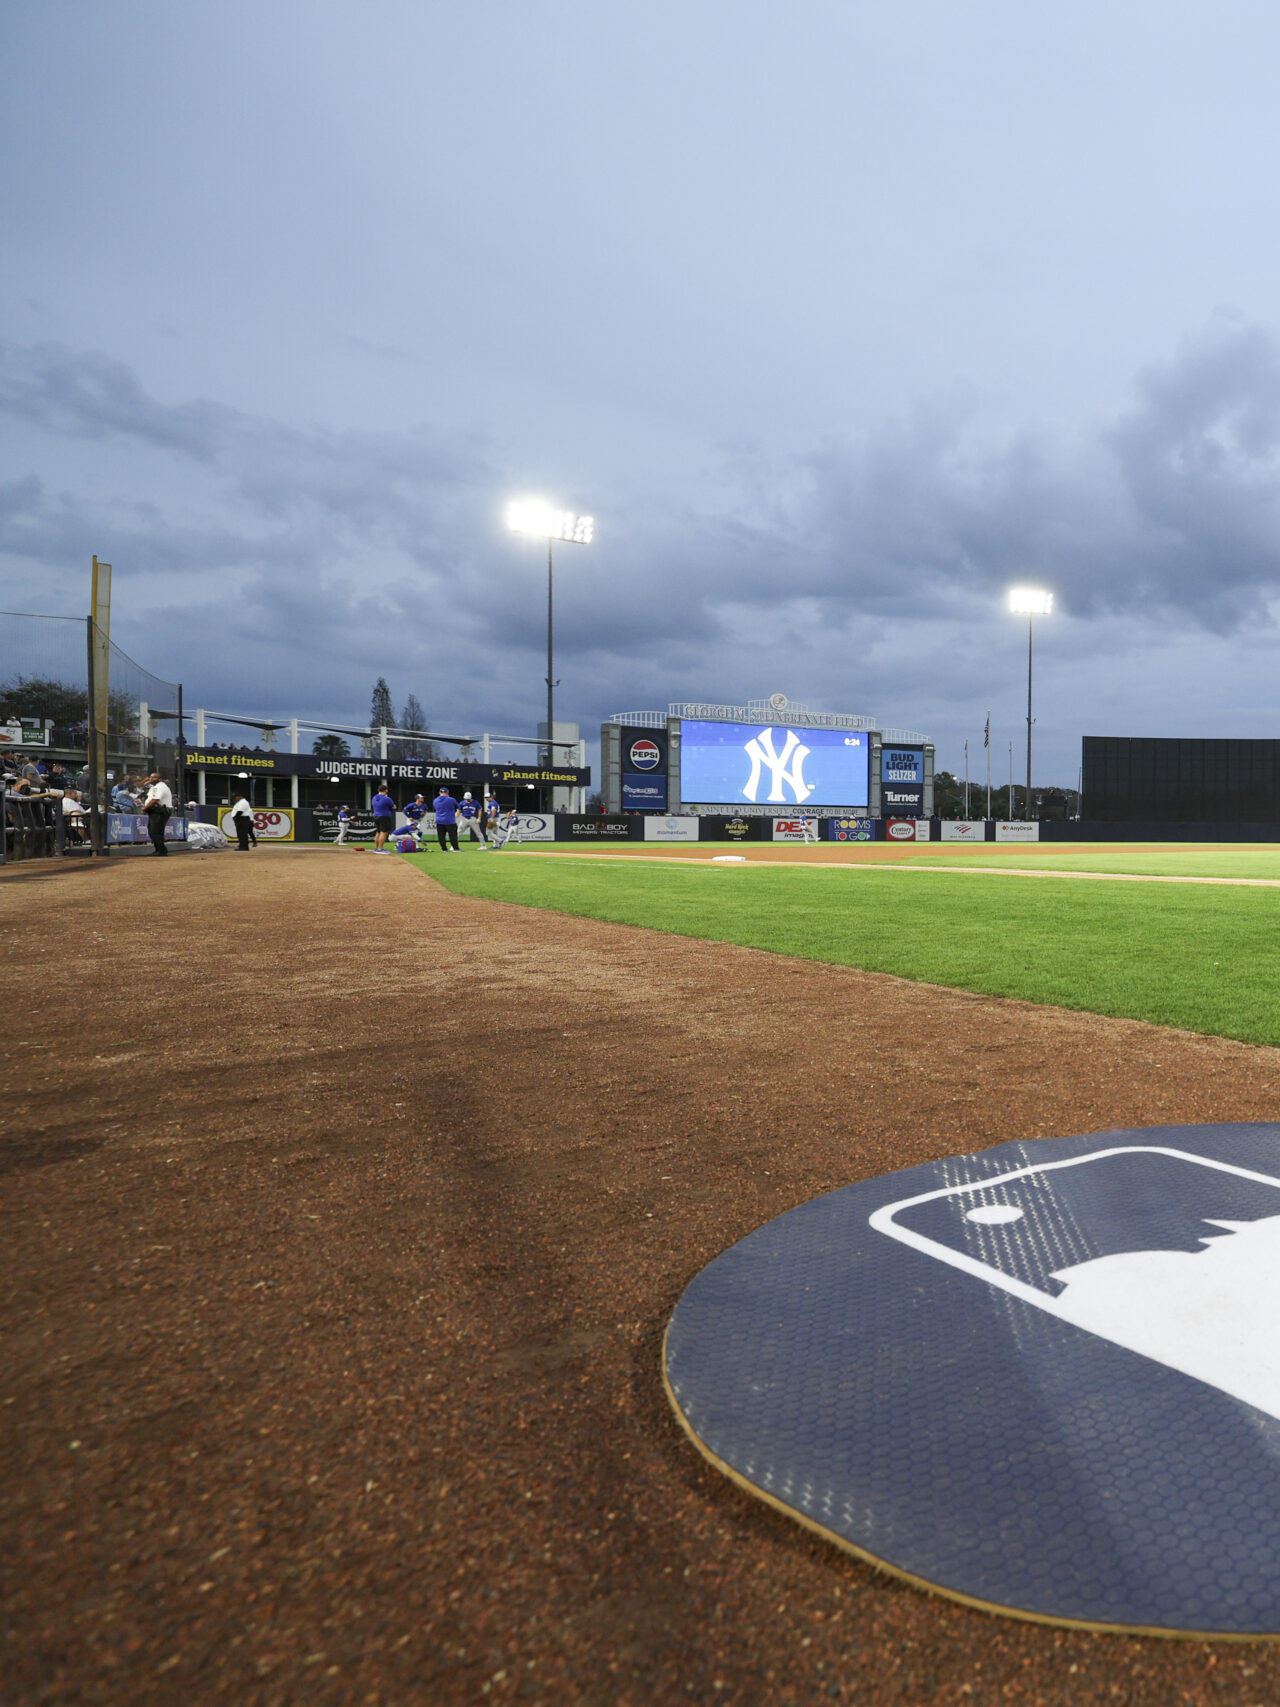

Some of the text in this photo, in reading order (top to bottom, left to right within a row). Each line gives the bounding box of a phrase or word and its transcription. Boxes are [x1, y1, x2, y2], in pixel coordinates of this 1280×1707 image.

[632, 750, 658, 758] PEPSI
[890, 753, 915, 762] BUD
[185, 752, 275, 767] planet fitness
[316, 761, 458, 779] JUDGEMENT FREE ZONE
[885, 762, 919, 770] LIGHT
[503, 769, 577, 781] planet fitness
[888, 770, 917, 781] SELTZER
[884, 791, 920, 802] Turner
[572, 823, 595, 831] BAD
[834, 820, 871, 829] ROOMS
[891, 821, 912, 834] Century
[834, 831, 866, 841] TO GO
